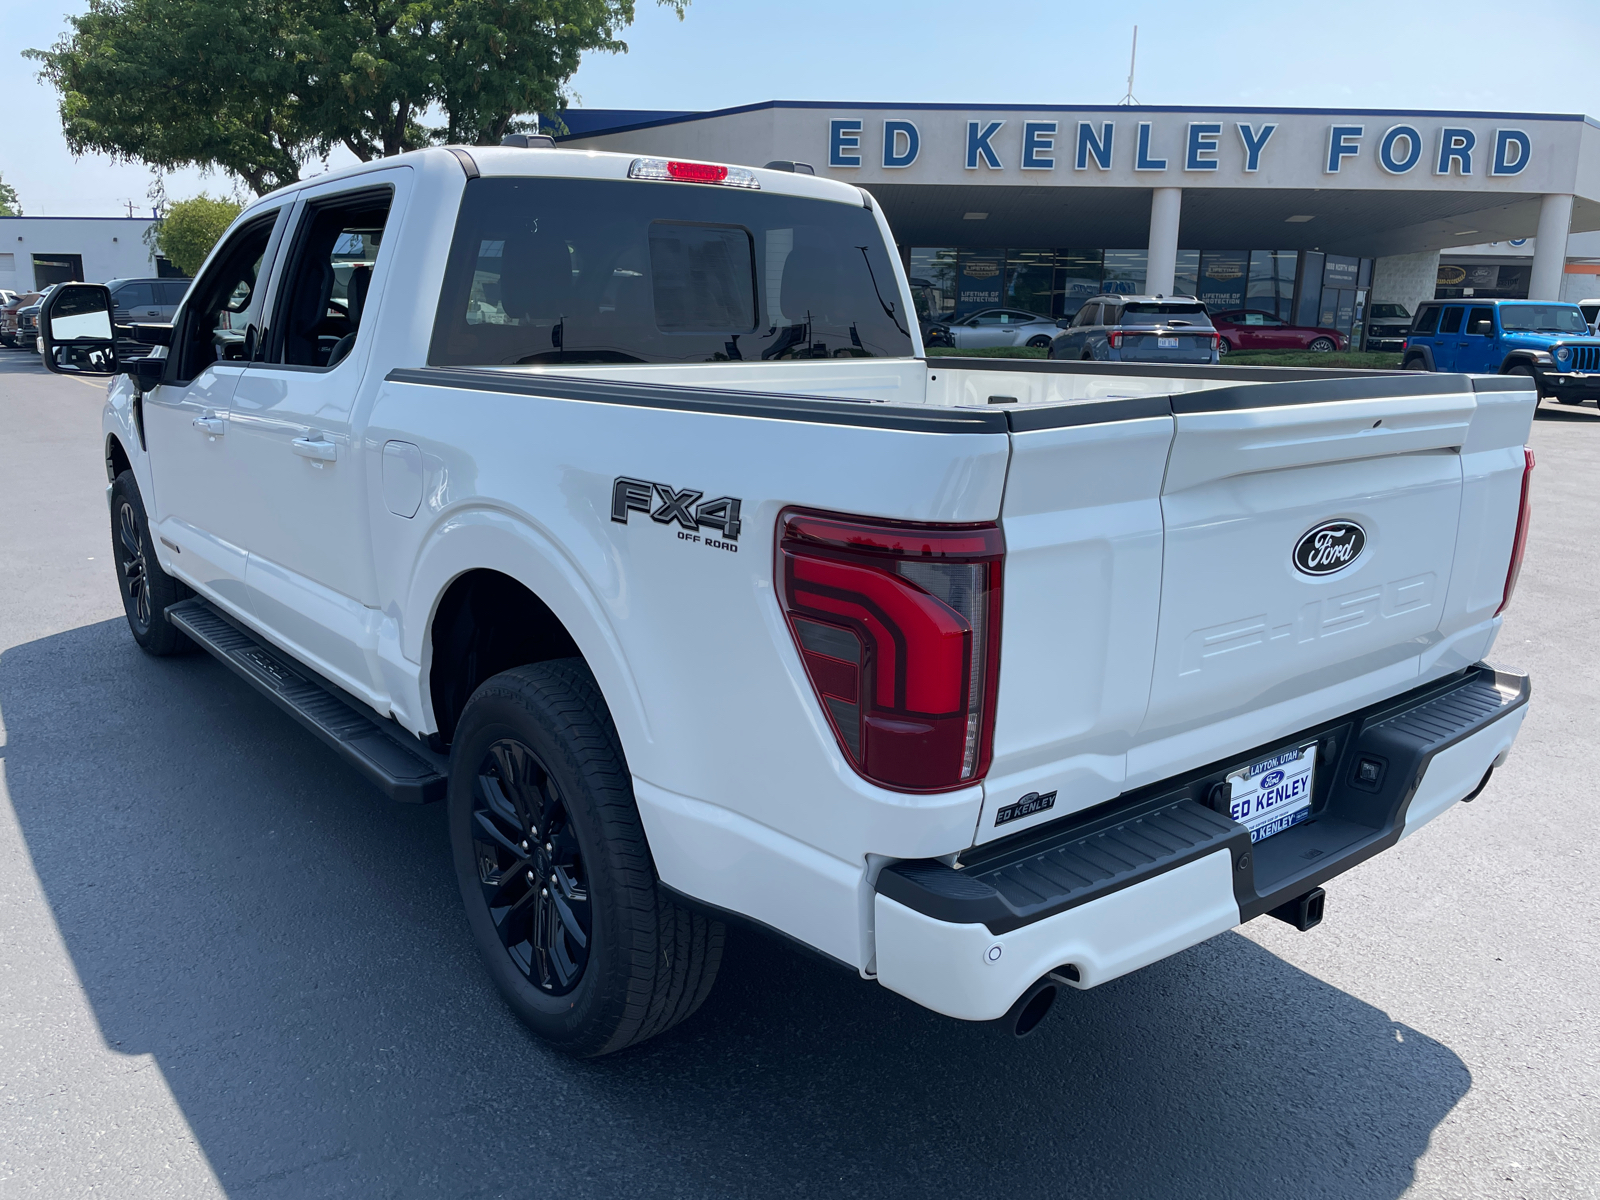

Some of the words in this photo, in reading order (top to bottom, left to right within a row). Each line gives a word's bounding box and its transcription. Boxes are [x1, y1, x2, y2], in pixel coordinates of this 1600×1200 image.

[828, 118, 921, 168] ED
[964, 119, 1279, 173] KENLEY
[1324, 123, 1532, 177] FORD
[610, 475, 743, 542] FX4
[677, 531, 701, 544] OFF
[704, 537, 738, 553] ROAD
[1307, 529, 1356, 568] Ford
[1179, 571, 1438, 677] F-150
[1250, 757, 1280, 776] LAYTON,
[1280, 749, 1298, 764] UTAH
[996, 809, 1012, 822] ED
[1014, 795, 1056, 817] KENLEY
[1231, 799, 1251, 820] ED
[1255, 775, 1309, 812] KENLEY
[1250, 832, 1258, 842] D
[1259, 814, 1294, 839] KENLEY
